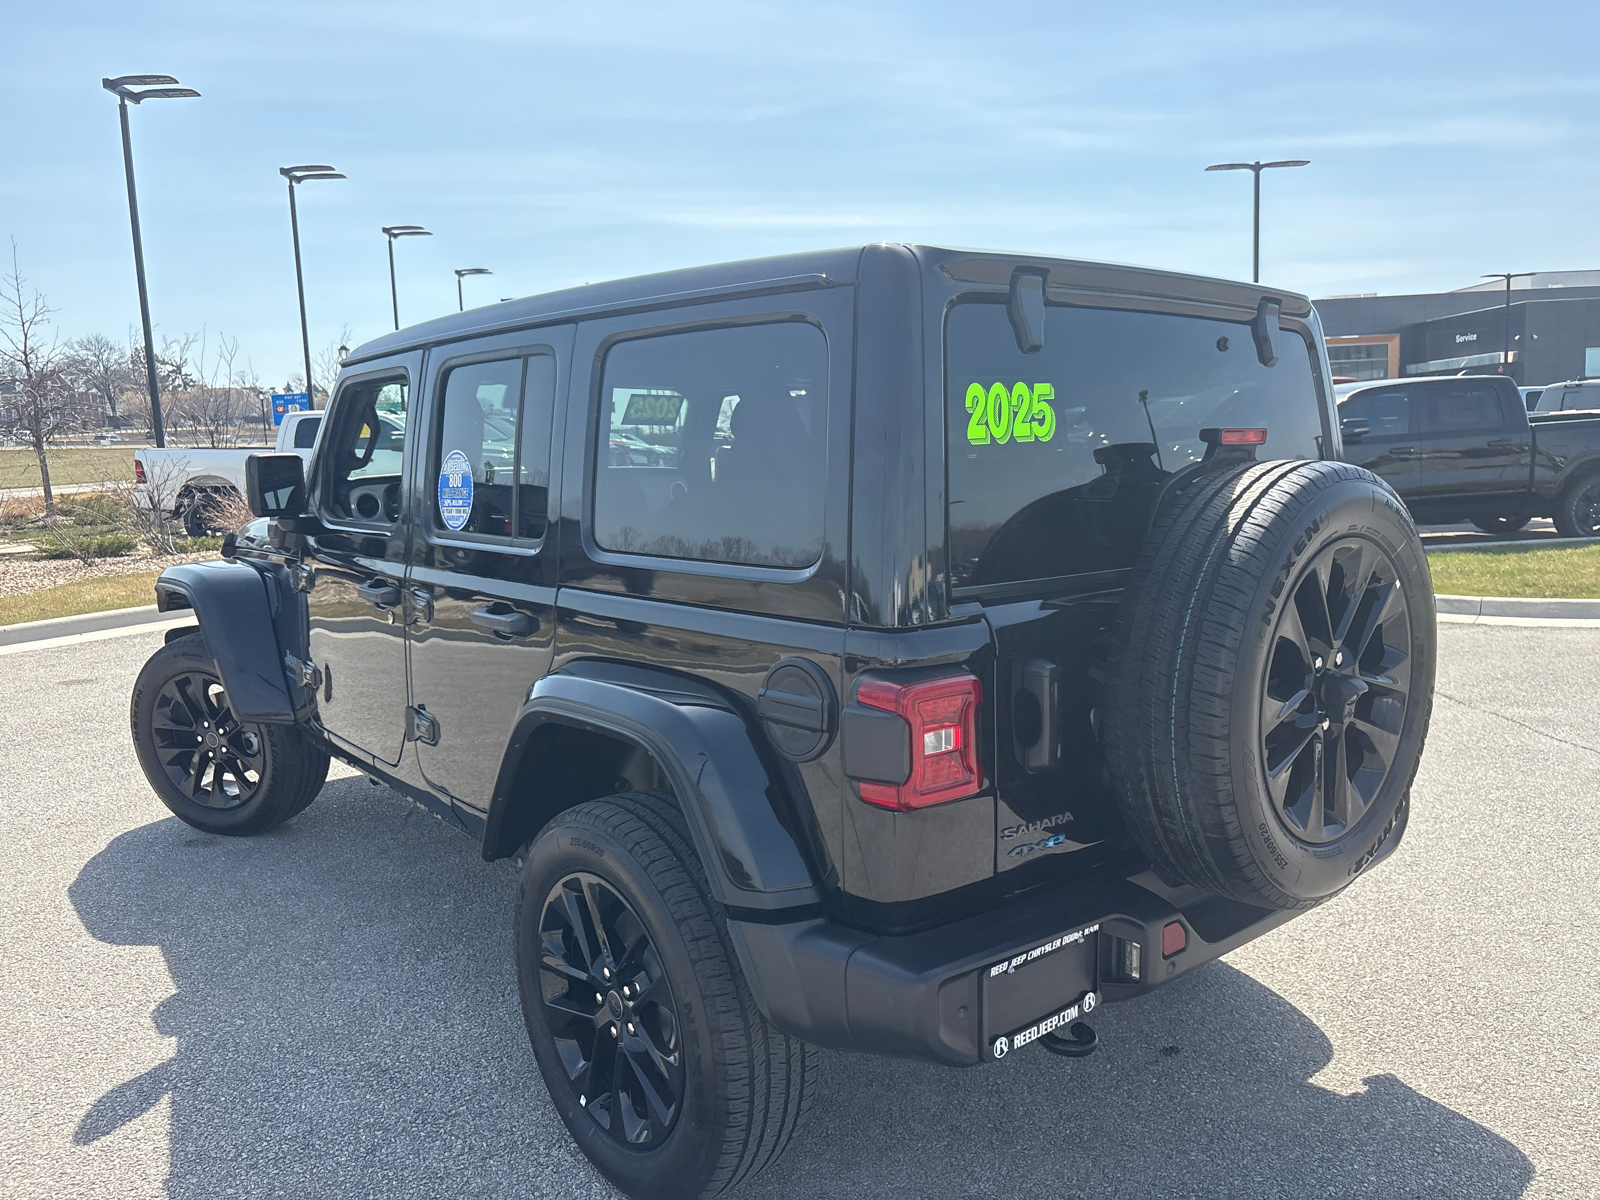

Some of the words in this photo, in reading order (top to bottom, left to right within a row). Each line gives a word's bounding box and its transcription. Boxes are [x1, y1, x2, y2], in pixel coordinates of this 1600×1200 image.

[1455, 333, 1478, 343] Service
[965, 382, 1056, 445] 2025
[449, 473, 462, 488] 800
[1260, 517, 1321, 627] NEXEN
[1001, 811, 1075, 840] SAHARA
[1259, 822, 1289, 870] 255/60R20
[990, 962, 1009, 978] REED
[1010, 953, 1027, 968] JEEP
[1027, 938, 1061, 961] CHRYSLER
[1013, 1004, 1079, 1050] REEDJEEP.COM
